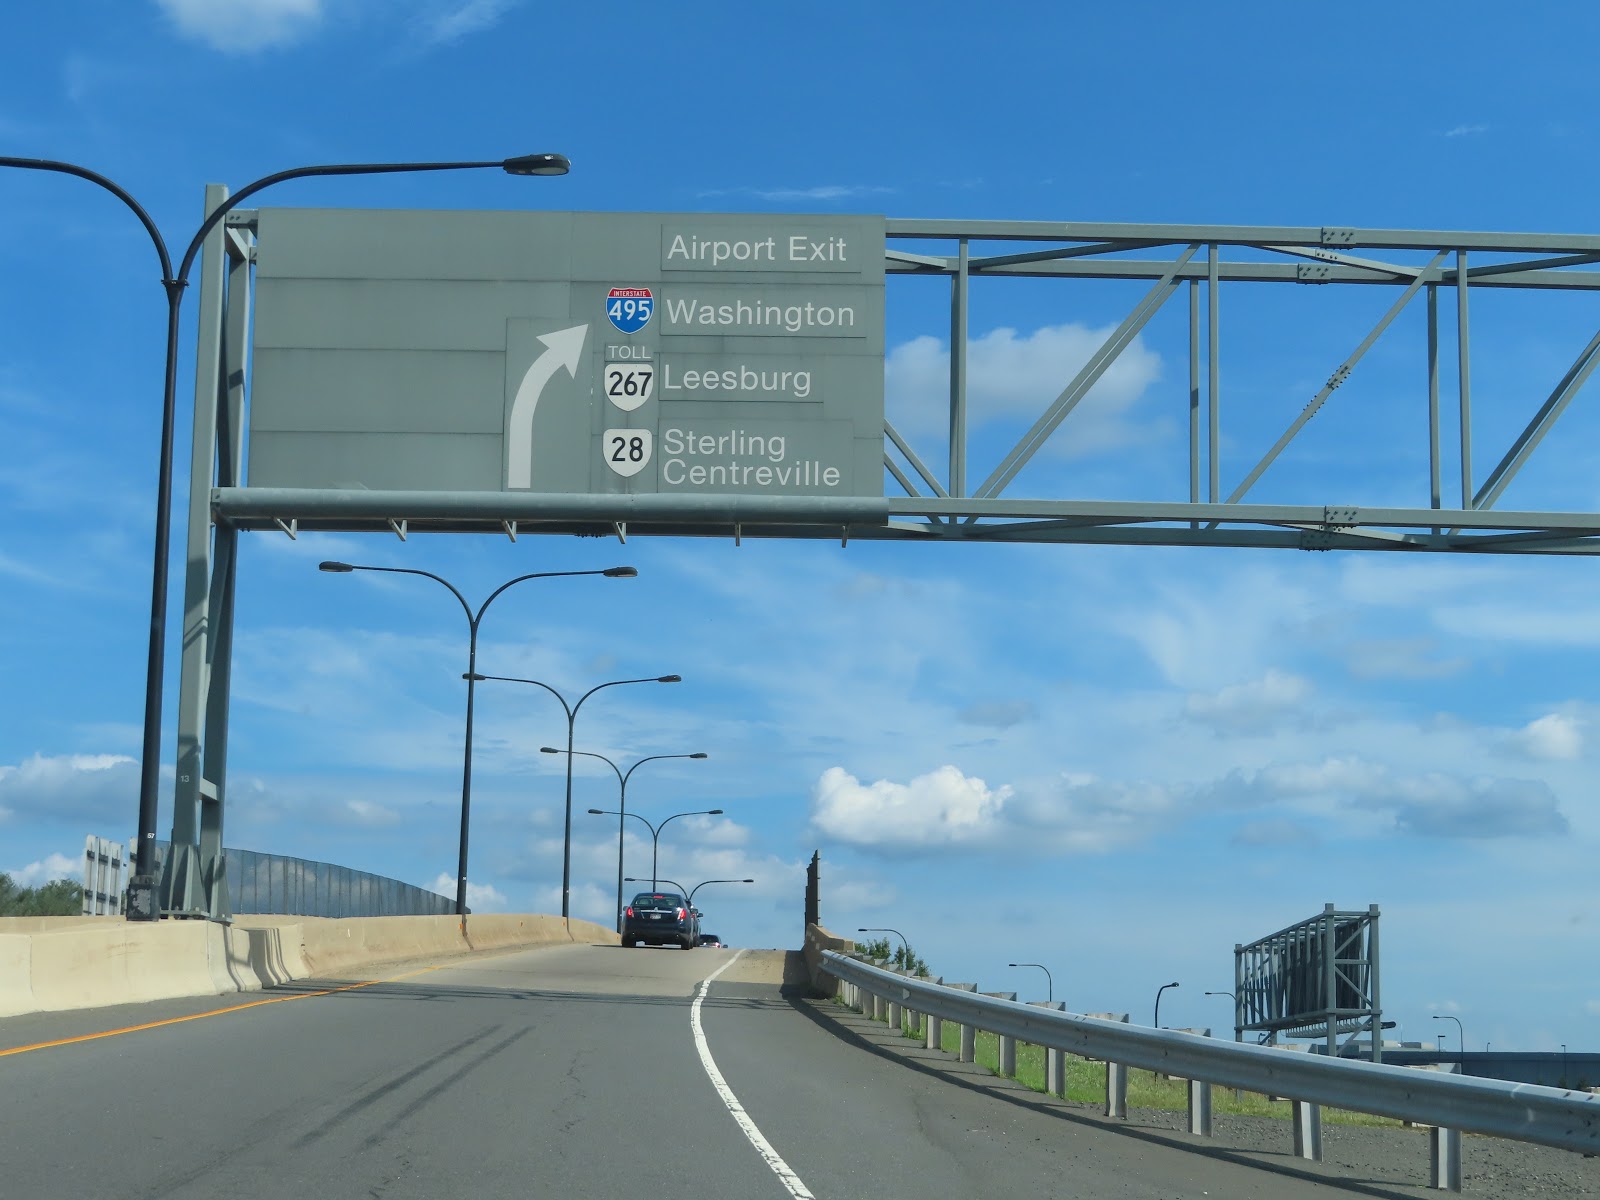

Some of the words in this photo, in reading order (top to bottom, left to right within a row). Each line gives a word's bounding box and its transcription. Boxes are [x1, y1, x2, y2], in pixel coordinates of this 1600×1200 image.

[667, 235, 776, 266] Airport
[789, 236, 848, 261] Exit
[609, 300, 650, 321] 495
[667, 299, 854, 332] Washington
[608, 345, 651, 359] TOLL
[609, 371, 652, 397] 267
[664, 364, 811, 397] Leesburg
[611, 436, 643, 462] 28
[664, 428, 785, 462] Sterling
[663, 458, 840, 486] Centreville
[180, 775, 190, 783] 13
